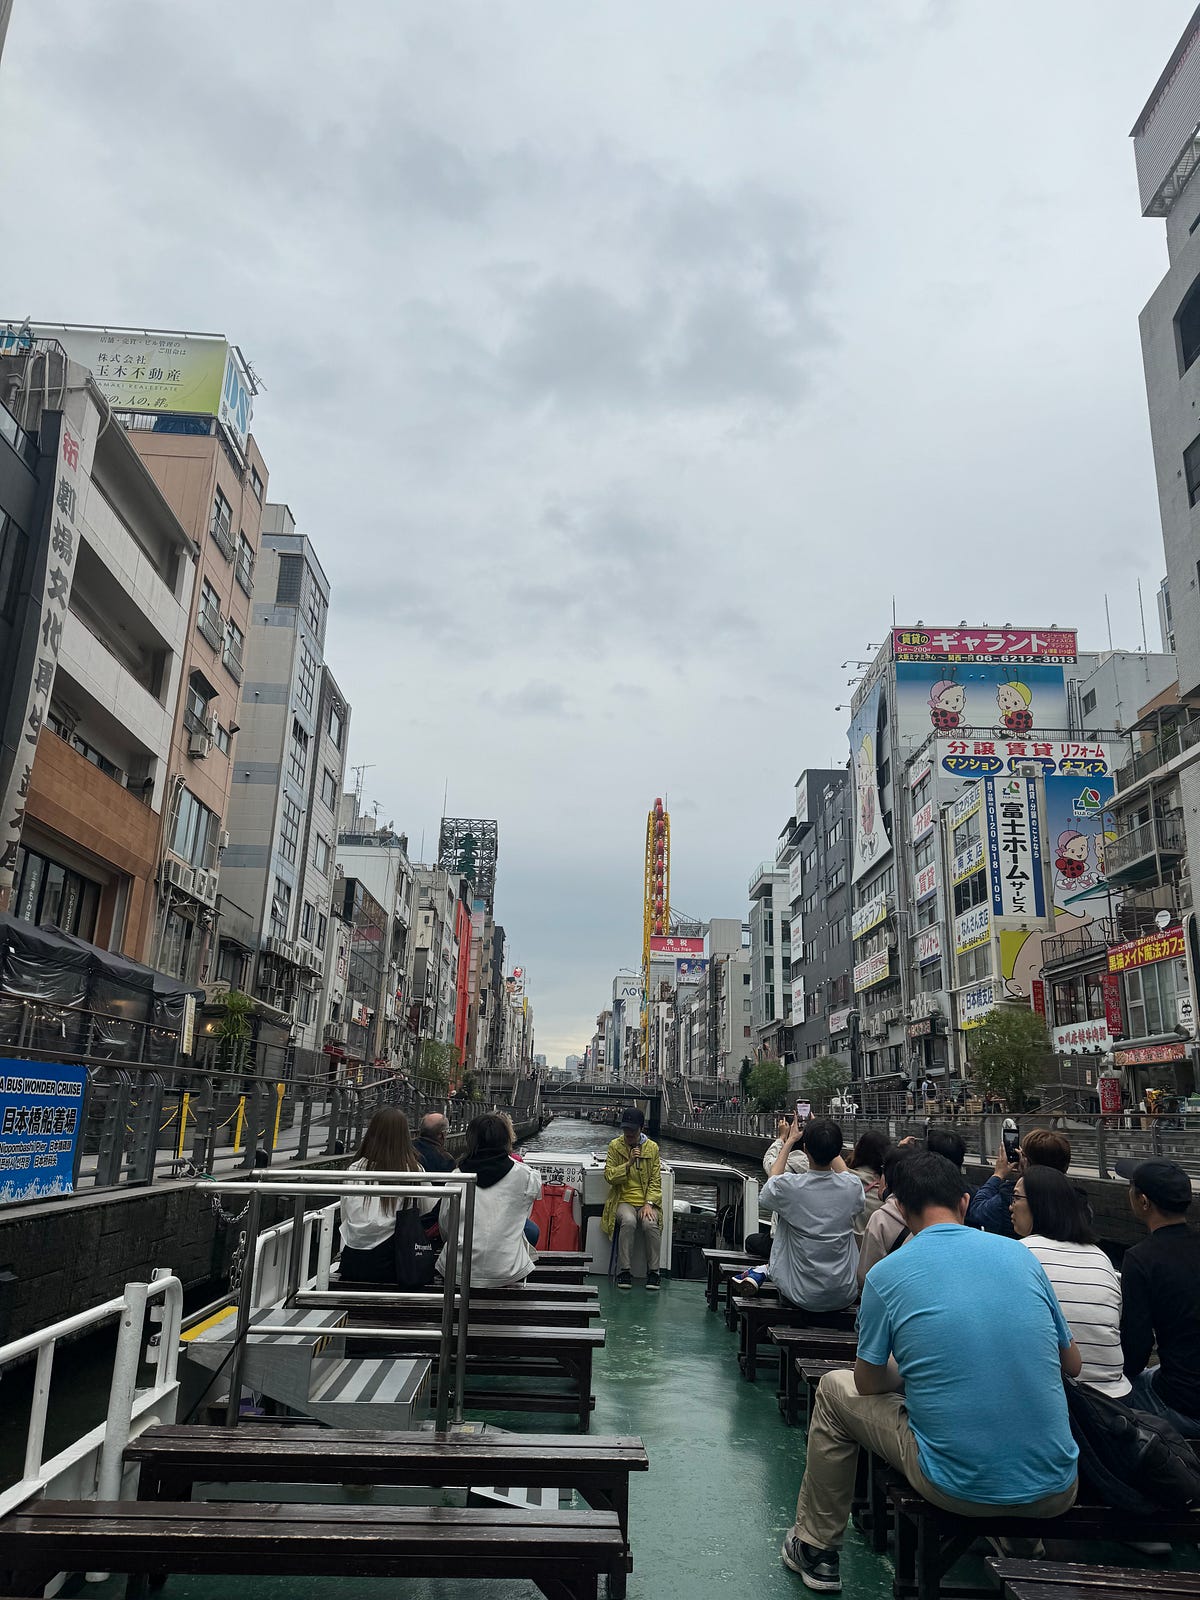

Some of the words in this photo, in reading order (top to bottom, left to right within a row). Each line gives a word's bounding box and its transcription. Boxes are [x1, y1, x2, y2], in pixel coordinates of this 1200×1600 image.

[98, 353, 146, 364] 株式会社
[932, 632, 1048, 652] ギャラント
[976, 655, 1074, 664] 06-6212-3013
[947, 741, 995, 755] 分譲
[1005, 742, 1054, 757] 賃貸
[1061, 744, 1105, 758] リフォーム
[946, 758, 1000, 771] マンション
[1000, 802, 1030, 913] 富士ホームサービス
[6, 1077, 22, 1093] BUS
[24, 1079, 56, 1094] WONDER
[57, 1082, 81, 1096] CRUISE
[2, 1106, 77, 1135] 日本橋船着場
